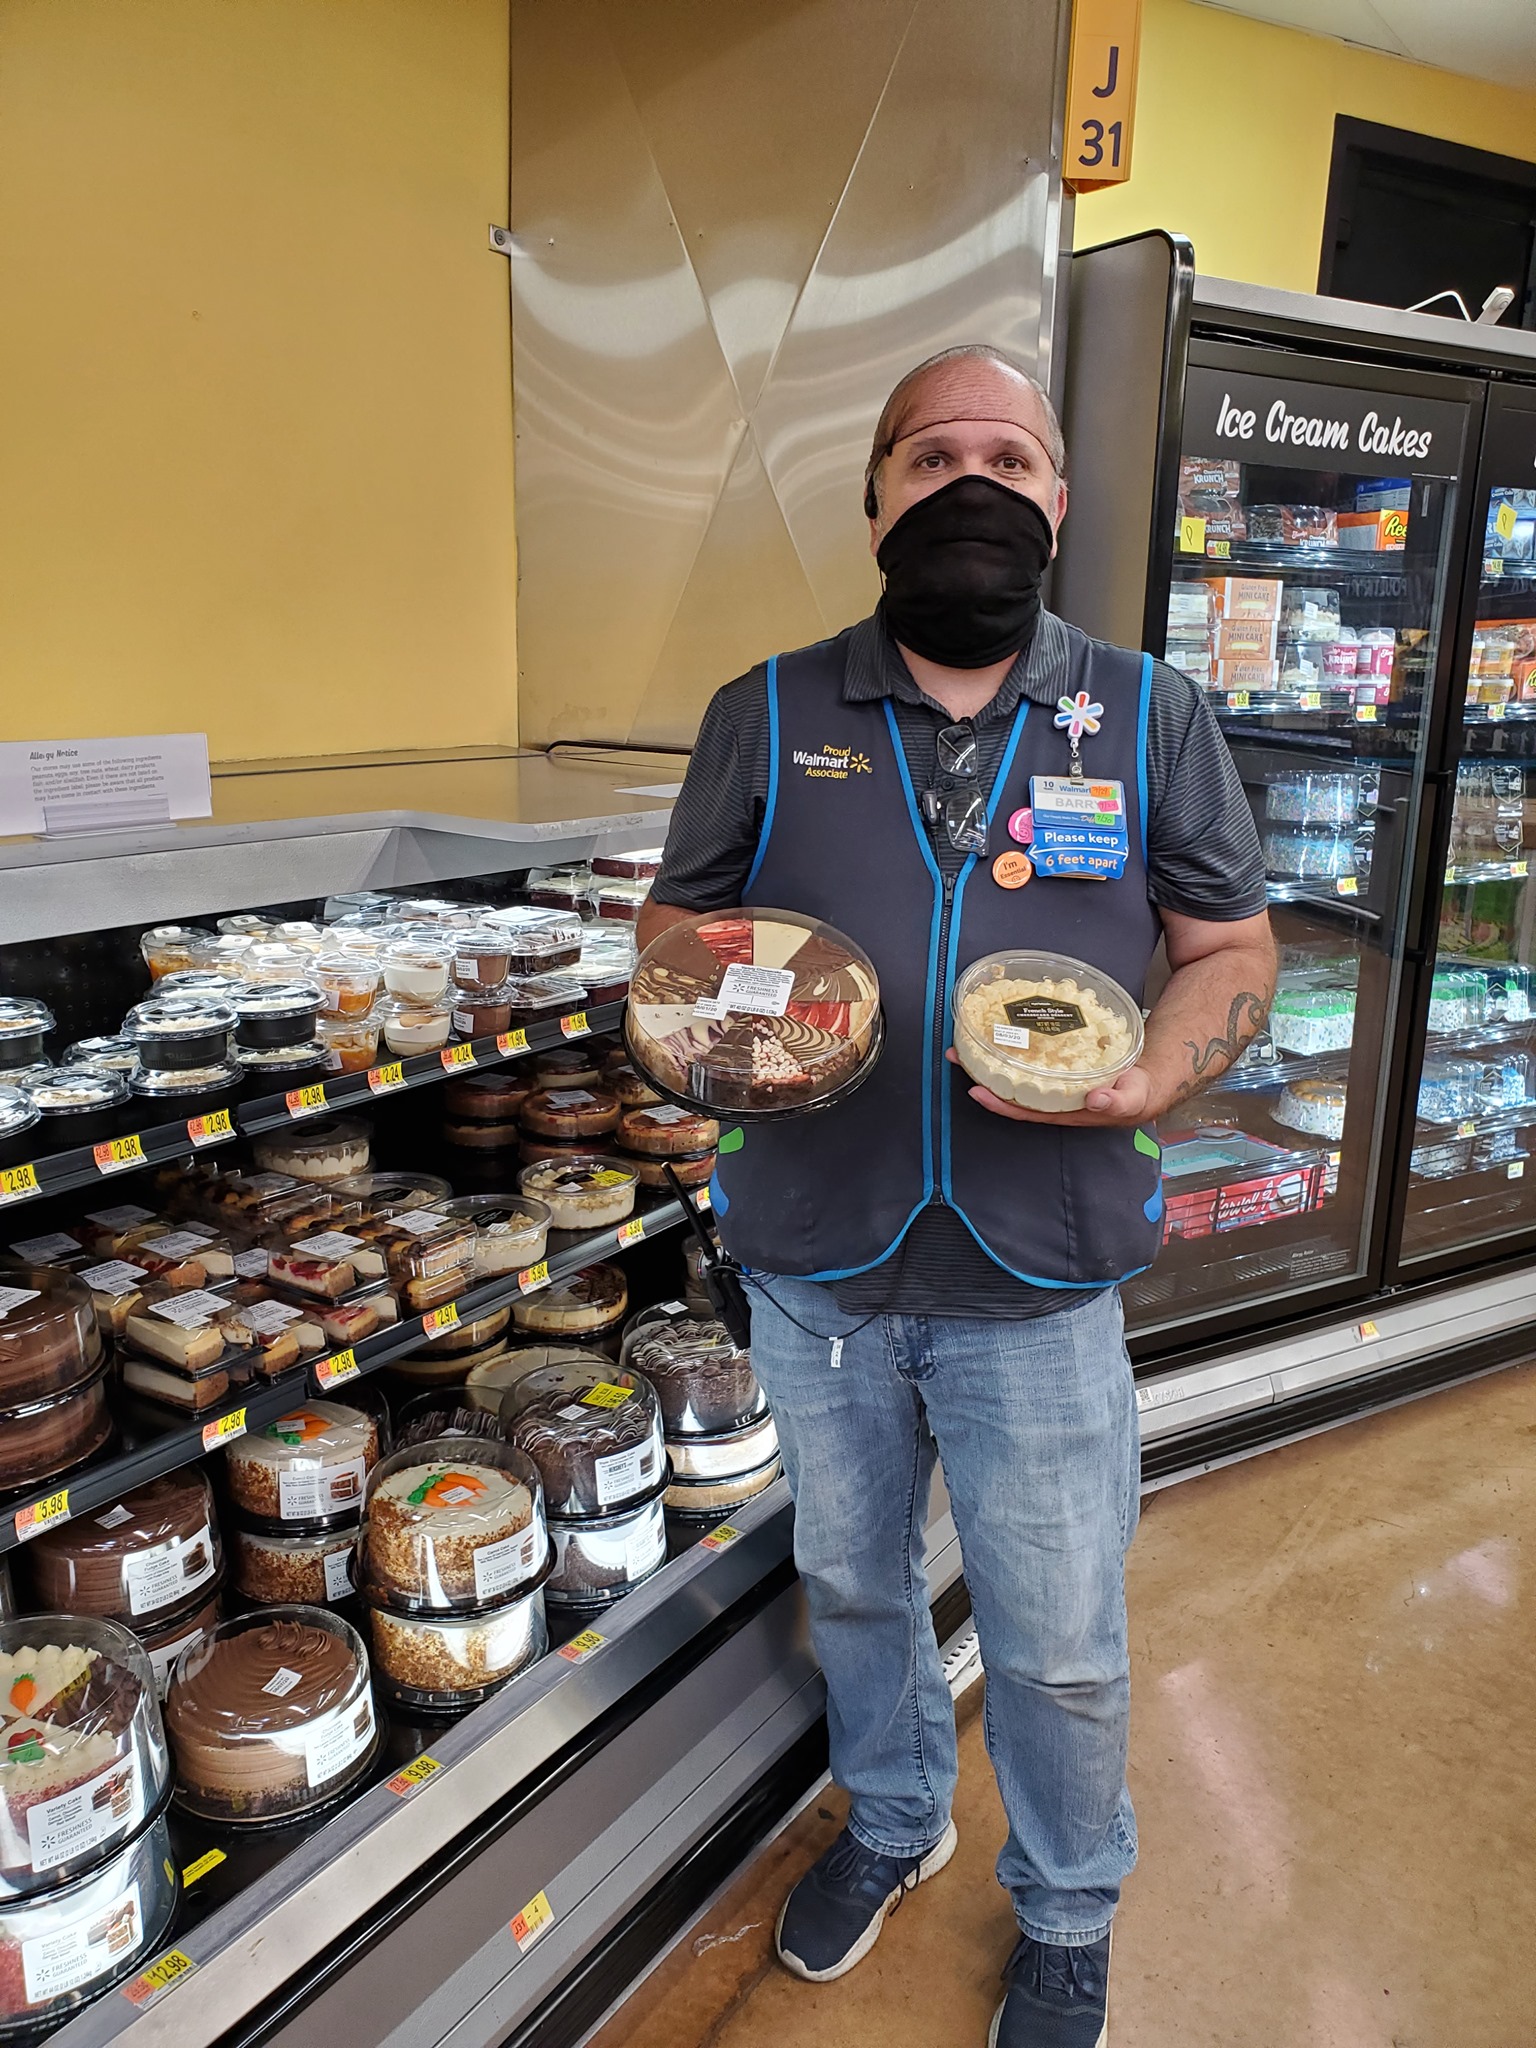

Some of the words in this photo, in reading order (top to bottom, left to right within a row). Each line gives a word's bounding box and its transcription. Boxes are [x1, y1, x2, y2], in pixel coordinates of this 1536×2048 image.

[1092, 46, 1119, 98] J
[1078, 119, 1122, 167] 31
[1215, 393, 1255, 440] Ice
[1265, 400, 1349, 450] Cream
[1358, 411, 1432, 458] Cakes
[1193, 474, 1224, 484] KRUNCH
[1204, 525, 1230, 533] RUNCH
[823, 744, 851, 757] Proud
[793, 750, 849, 769] Walmart
[805, 766, 848, 779] Associate
[1044, 832, 1085, 843] Please
[1088, 832, 1118, 847] keep
[1003, 860, 1018, 870] I'm
[1045, 855, 1054, 867] 6
[1057, 855, 1085, 865] feet
[1088, 856, 1118, 870] apart
[1000, 866, 1027, 879] Essential
[746, 985, 778, 994] FRESHNESS
[46, 1802, 67, 1814] Variety
[67, 1795, 82, 1805] Cake
[57, 1817, 92, 1838] FRESHNESS
[57, 1824, 93, 1844] GUARANTEED
[52, 1953, 87, 1972] FRESHNESS
[52, 1959, 88, 1978] GUARANTEED
